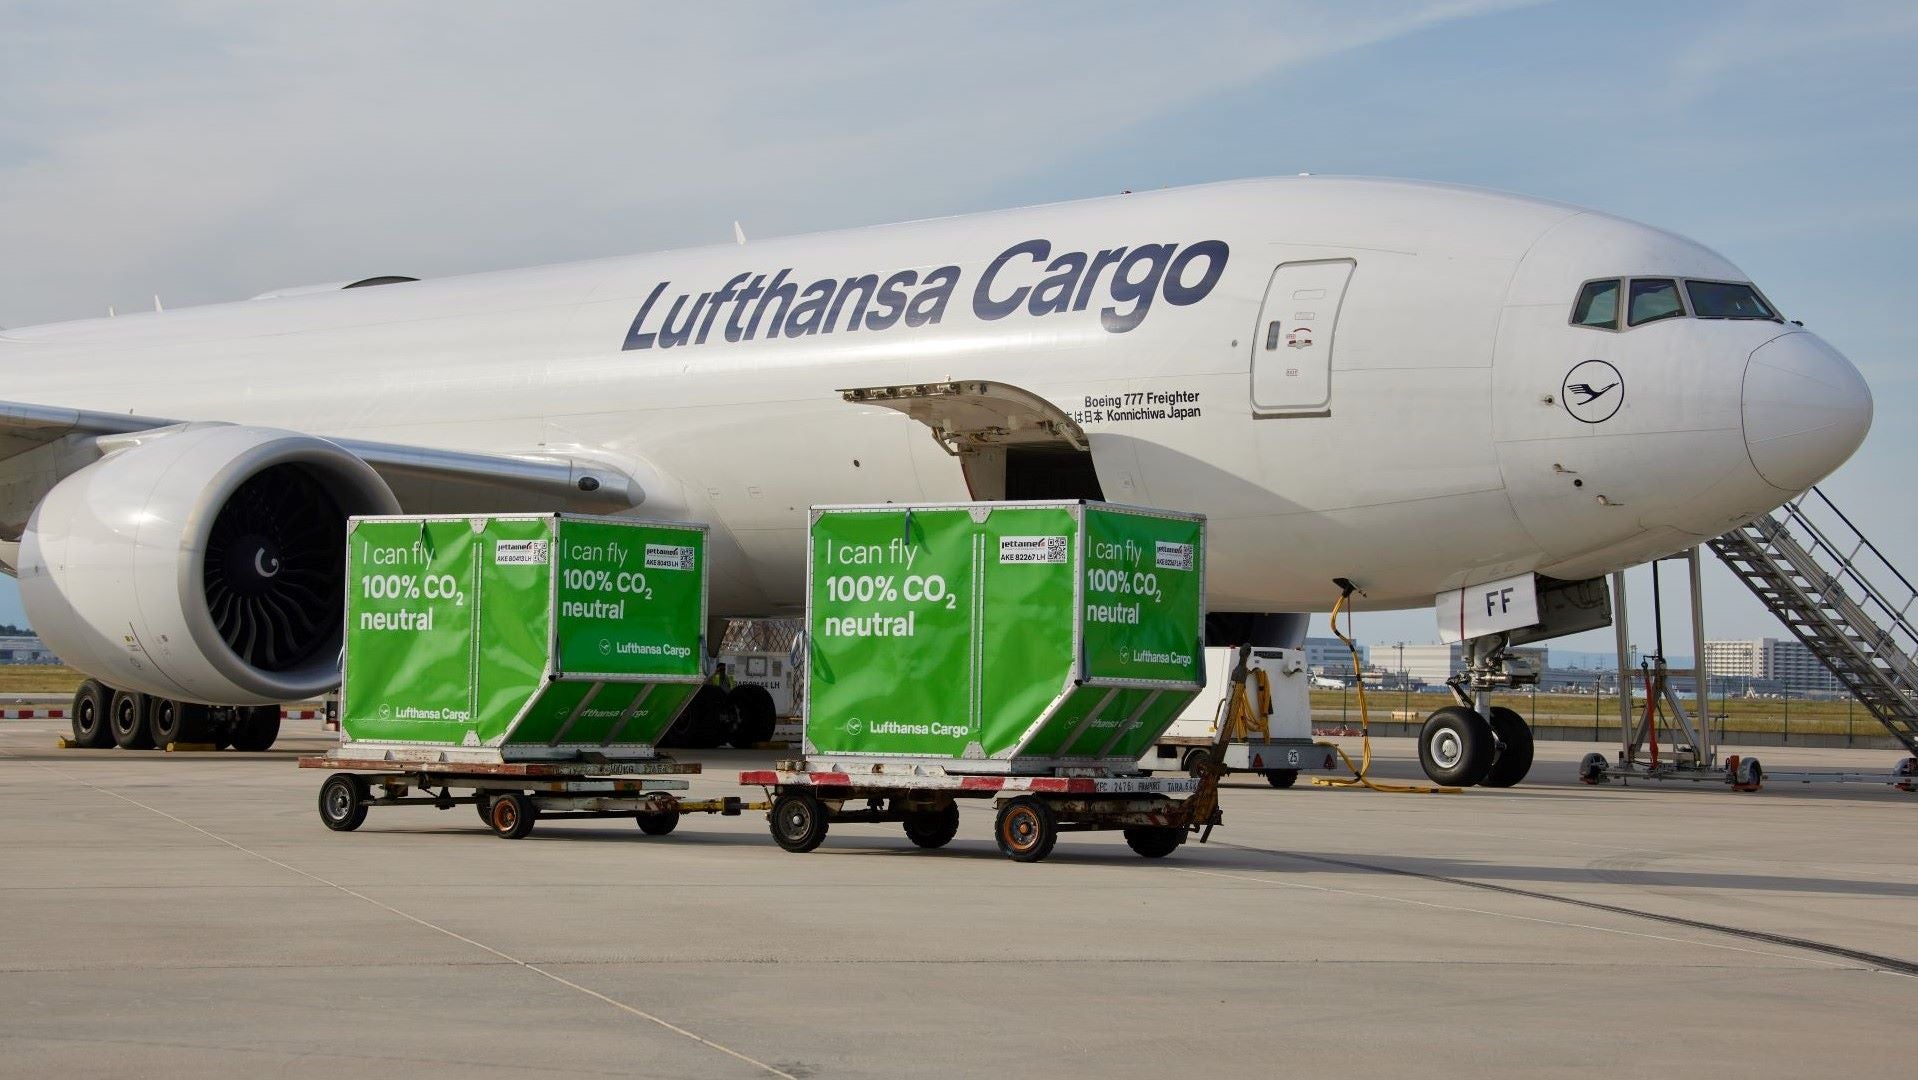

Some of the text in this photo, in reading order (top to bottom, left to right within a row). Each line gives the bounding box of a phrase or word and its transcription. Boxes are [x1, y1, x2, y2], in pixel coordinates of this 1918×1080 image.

[622, 239, 1230, 351] Lufthansa Cargo
[1085, 391, 1200, 408] Boeing 777 Freighter
[1066, 406, 1201, 423] は日本 Konnichiwa Japan
[363, 541, 435, 570] I can fly
[563, 539, 629, 567] I can fly
[827, 538, 918, 571] I can fly
[1087, 536, 1142, 567] I can fly
[362, 575, 419, 599] 100%
[563, 569, 613, 592] 100%
[826, 575, 897, 602] 100%
[1088, 568, 1131, 594] 100%
[562, 599, 624, 620] neutral
[1087, 602, 1140, 625] neutral
[1486, 587, 1513, 617] FF
[360, 607, 433, 631] neutral
[825, 610, 914, 637] neutral
[616, 642, 691, 657] Lufthansa Cargo
[1133, 649, 1192, 667] Lufthansa Cargo
[395, 706, 471, 722] Lufthansa Cargo
[870, 721, 969, 737] Lufthansa Cargo
[1289, 751, 1298, 762] 25
